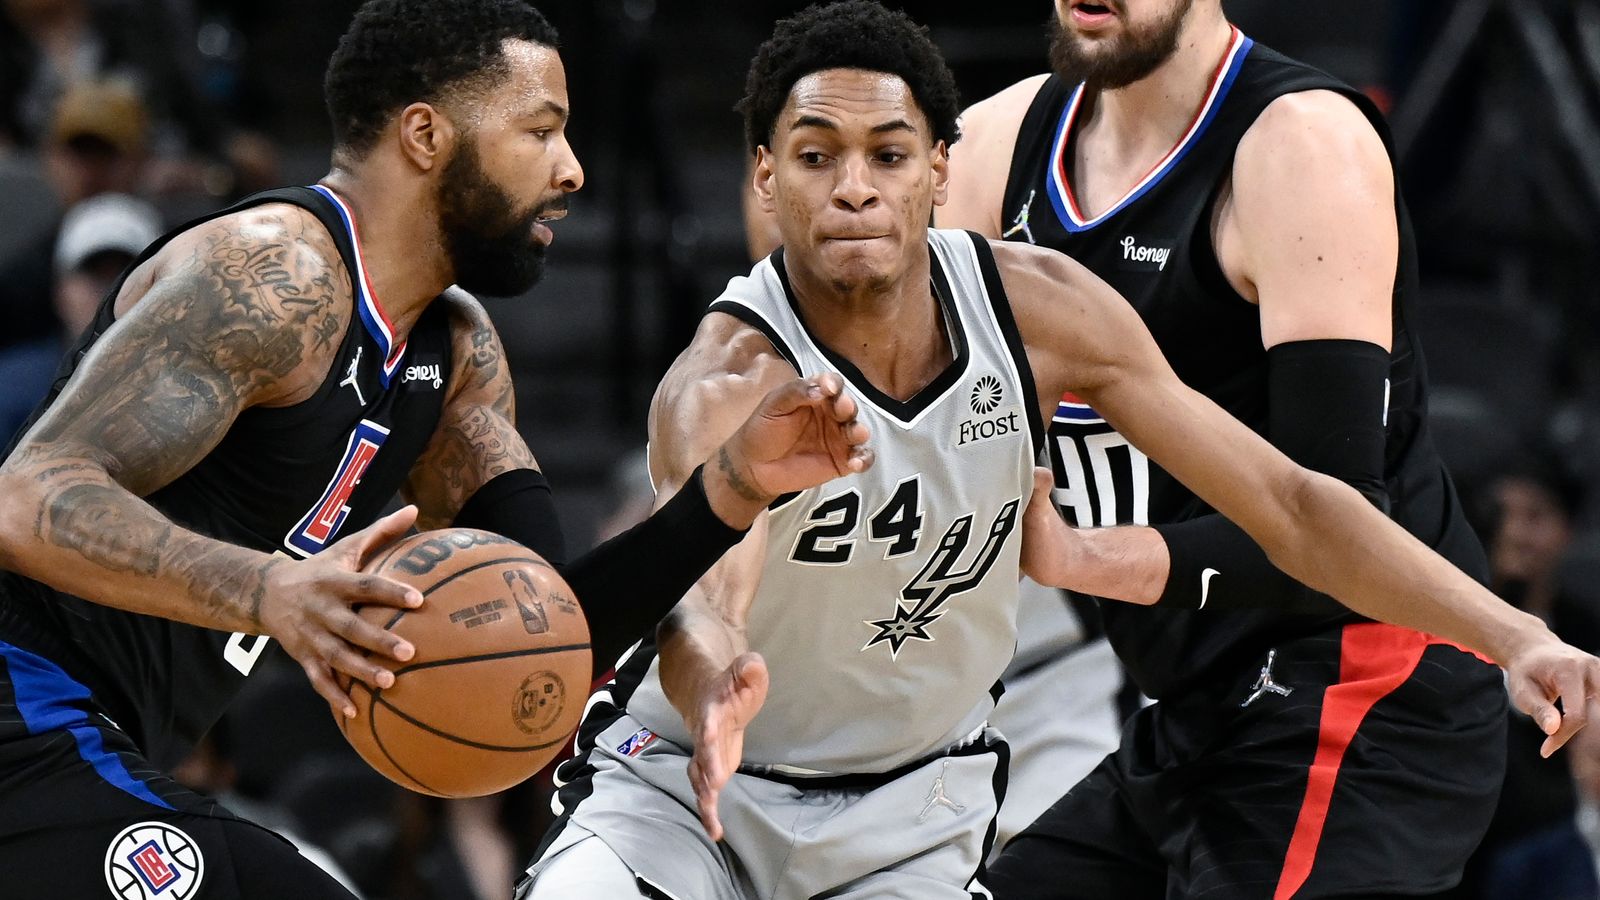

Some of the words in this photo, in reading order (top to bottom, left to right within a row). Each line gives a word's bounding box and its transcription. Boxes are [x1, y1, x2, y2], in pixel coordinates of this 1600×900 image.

[1120, 235, 1171, 271] honey
[401, 364, 443, 389] oney
[957, 410, 1020, 446] Frost
[787, 473, 925, 566] 24
